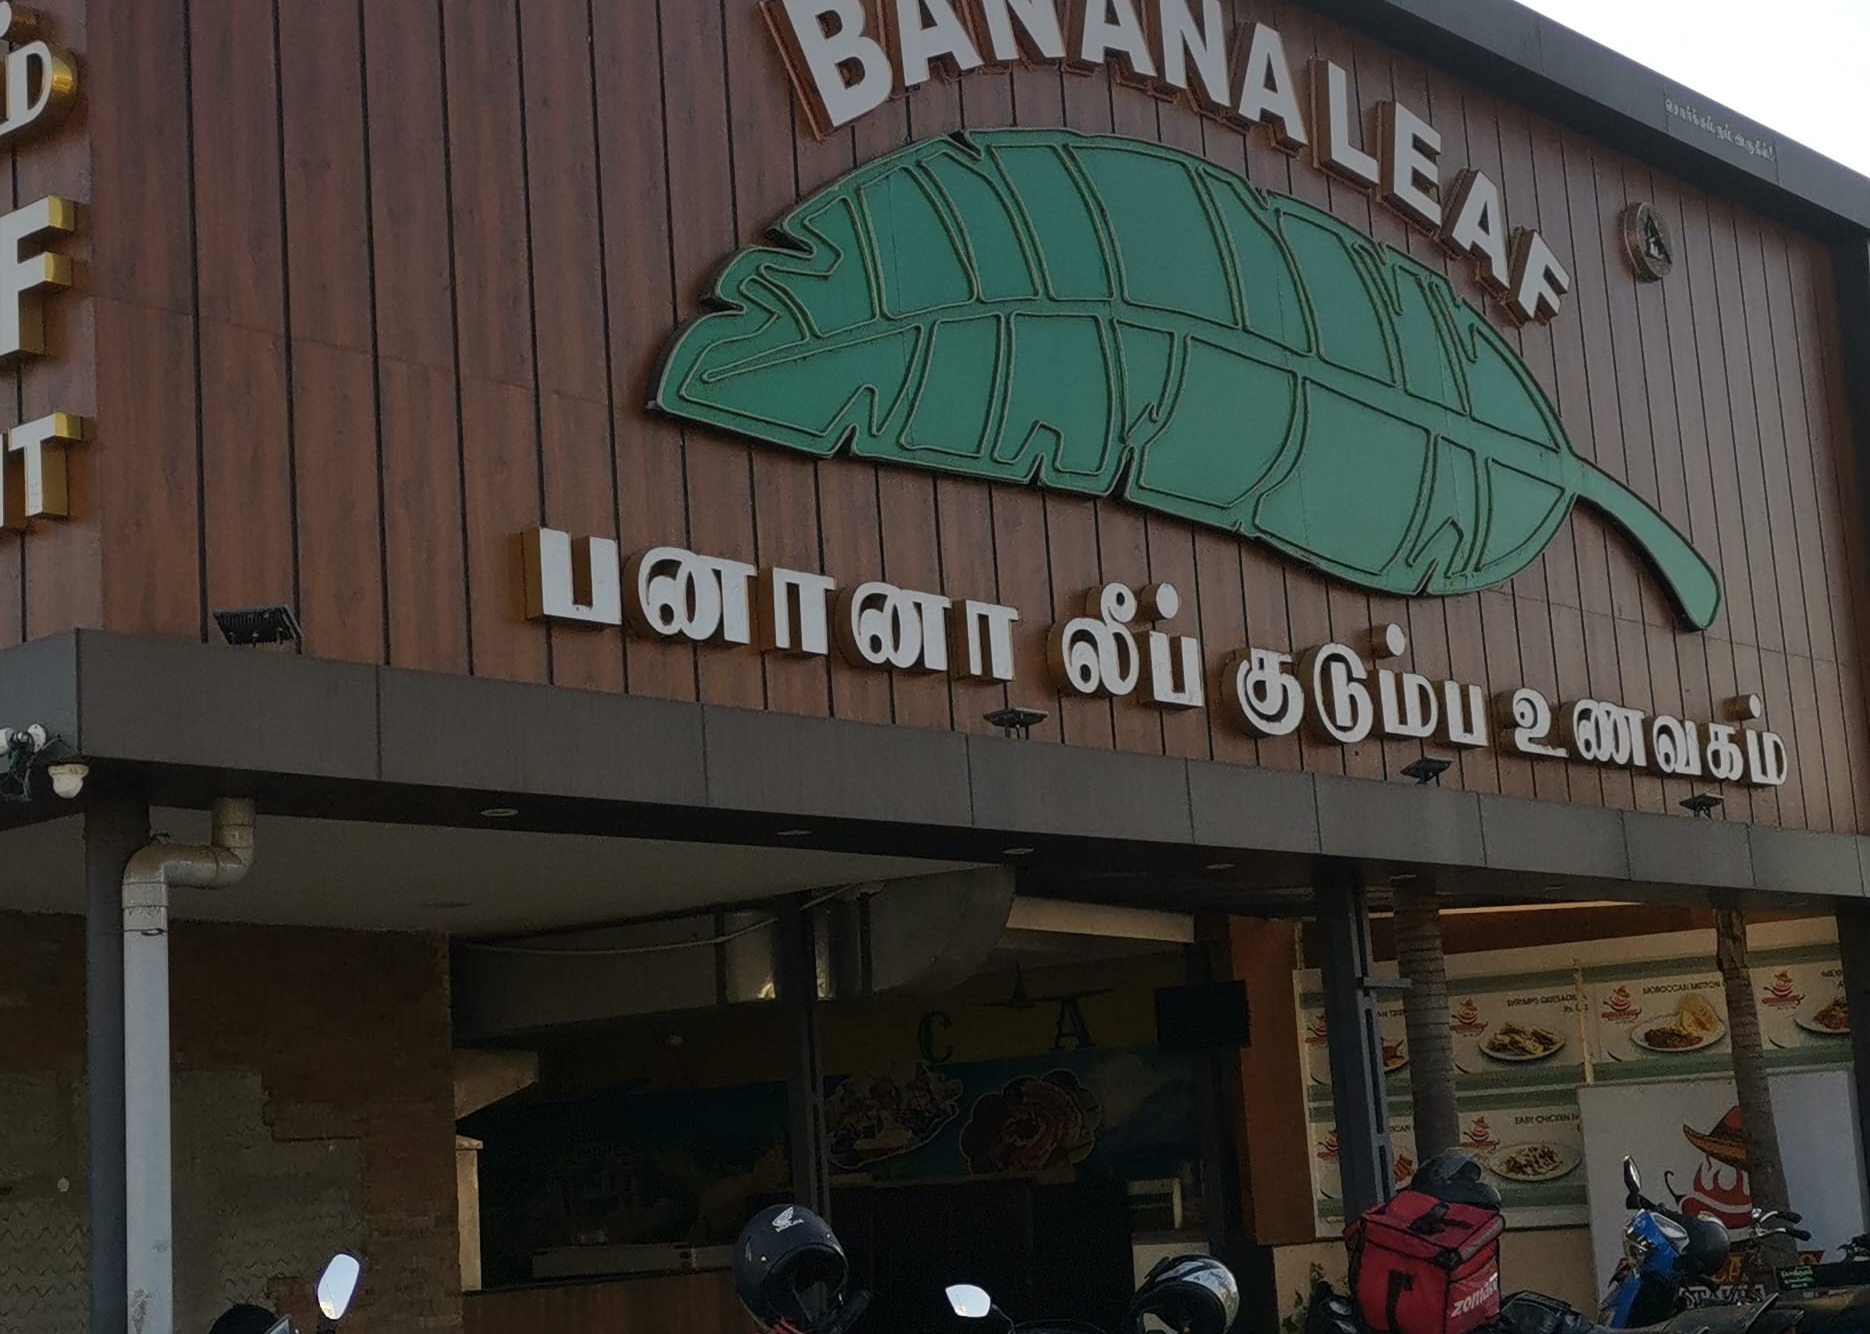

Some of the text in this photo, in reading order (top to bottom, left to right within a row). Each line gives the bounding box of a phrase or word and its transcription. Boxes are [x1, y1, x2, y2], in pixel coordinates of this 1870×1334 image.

[1324, 59, 1572, 322] LEAF
[538, 526, 1789, 787] பனானா லீப் குடும்ப உணவகம்
